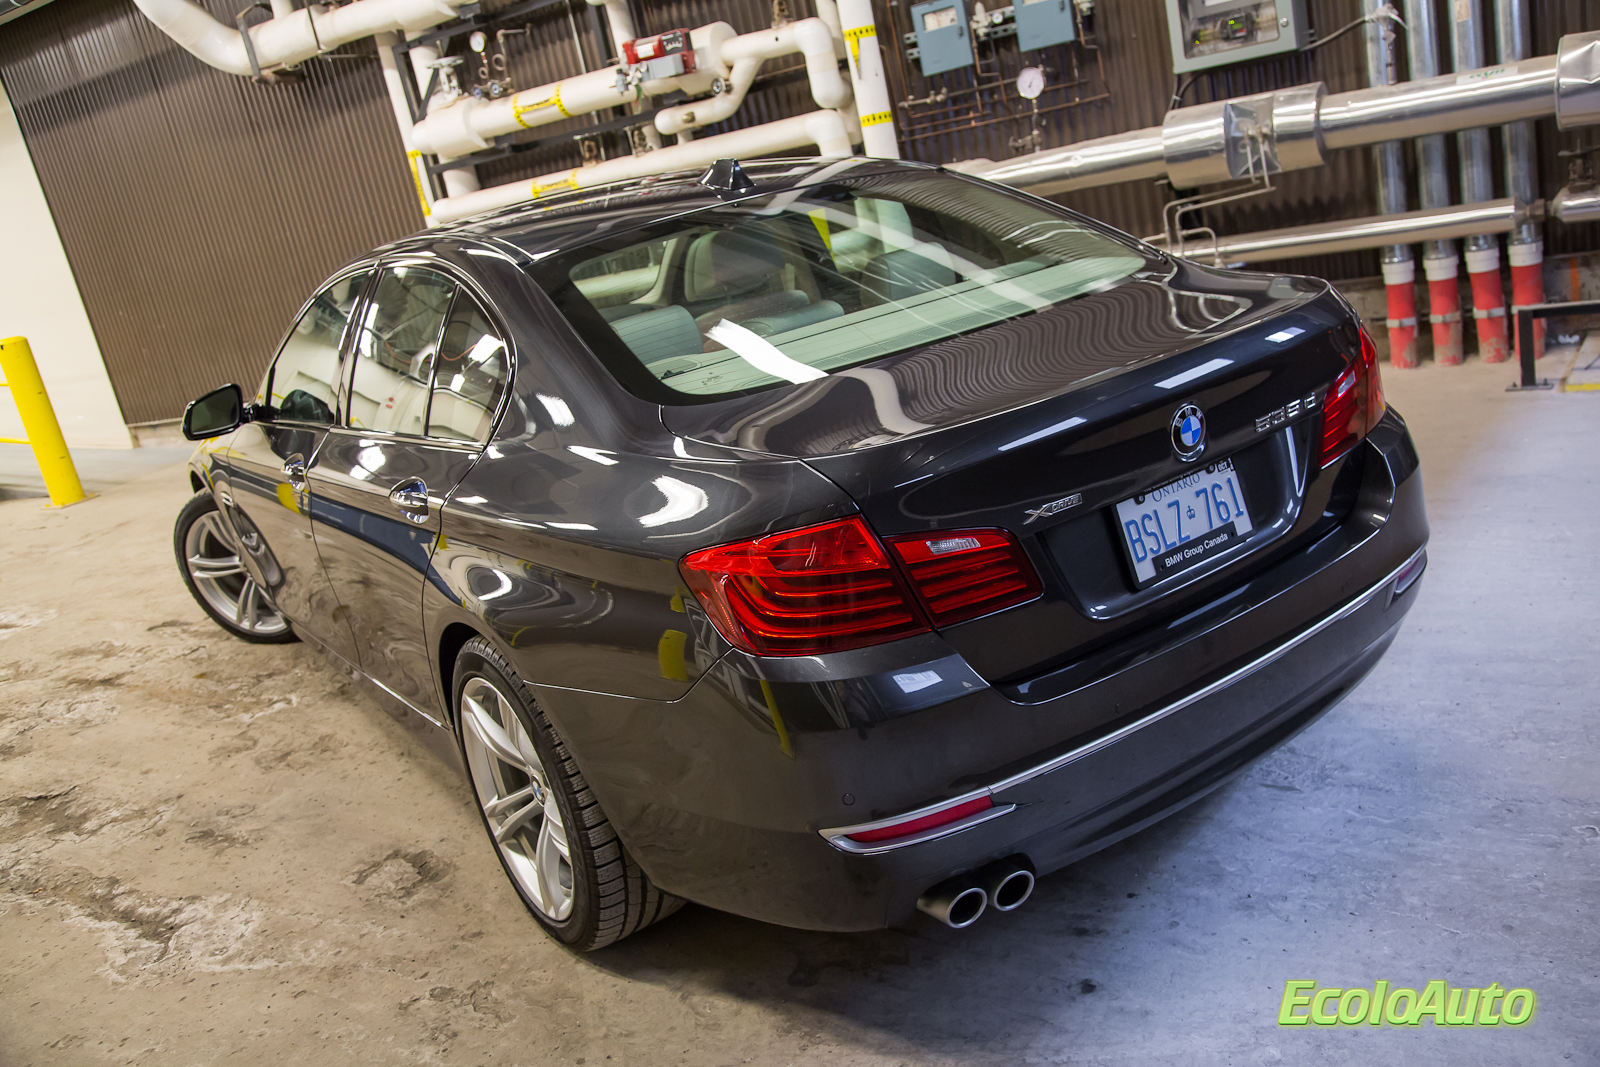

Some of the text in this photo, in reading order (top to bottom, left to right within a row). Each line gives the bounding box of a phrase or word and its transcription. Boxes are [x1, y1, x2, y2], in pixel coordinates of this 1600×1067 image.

[1174, 406, 1203, 428] BMW
[1151, 472, 1201, 502] ONTARIO
[1124, 499, 1191, 563] BSLZ
[1195, 476, 1245, 529] 761
[1164, 532, 1229, 568] BMW Group Canada
